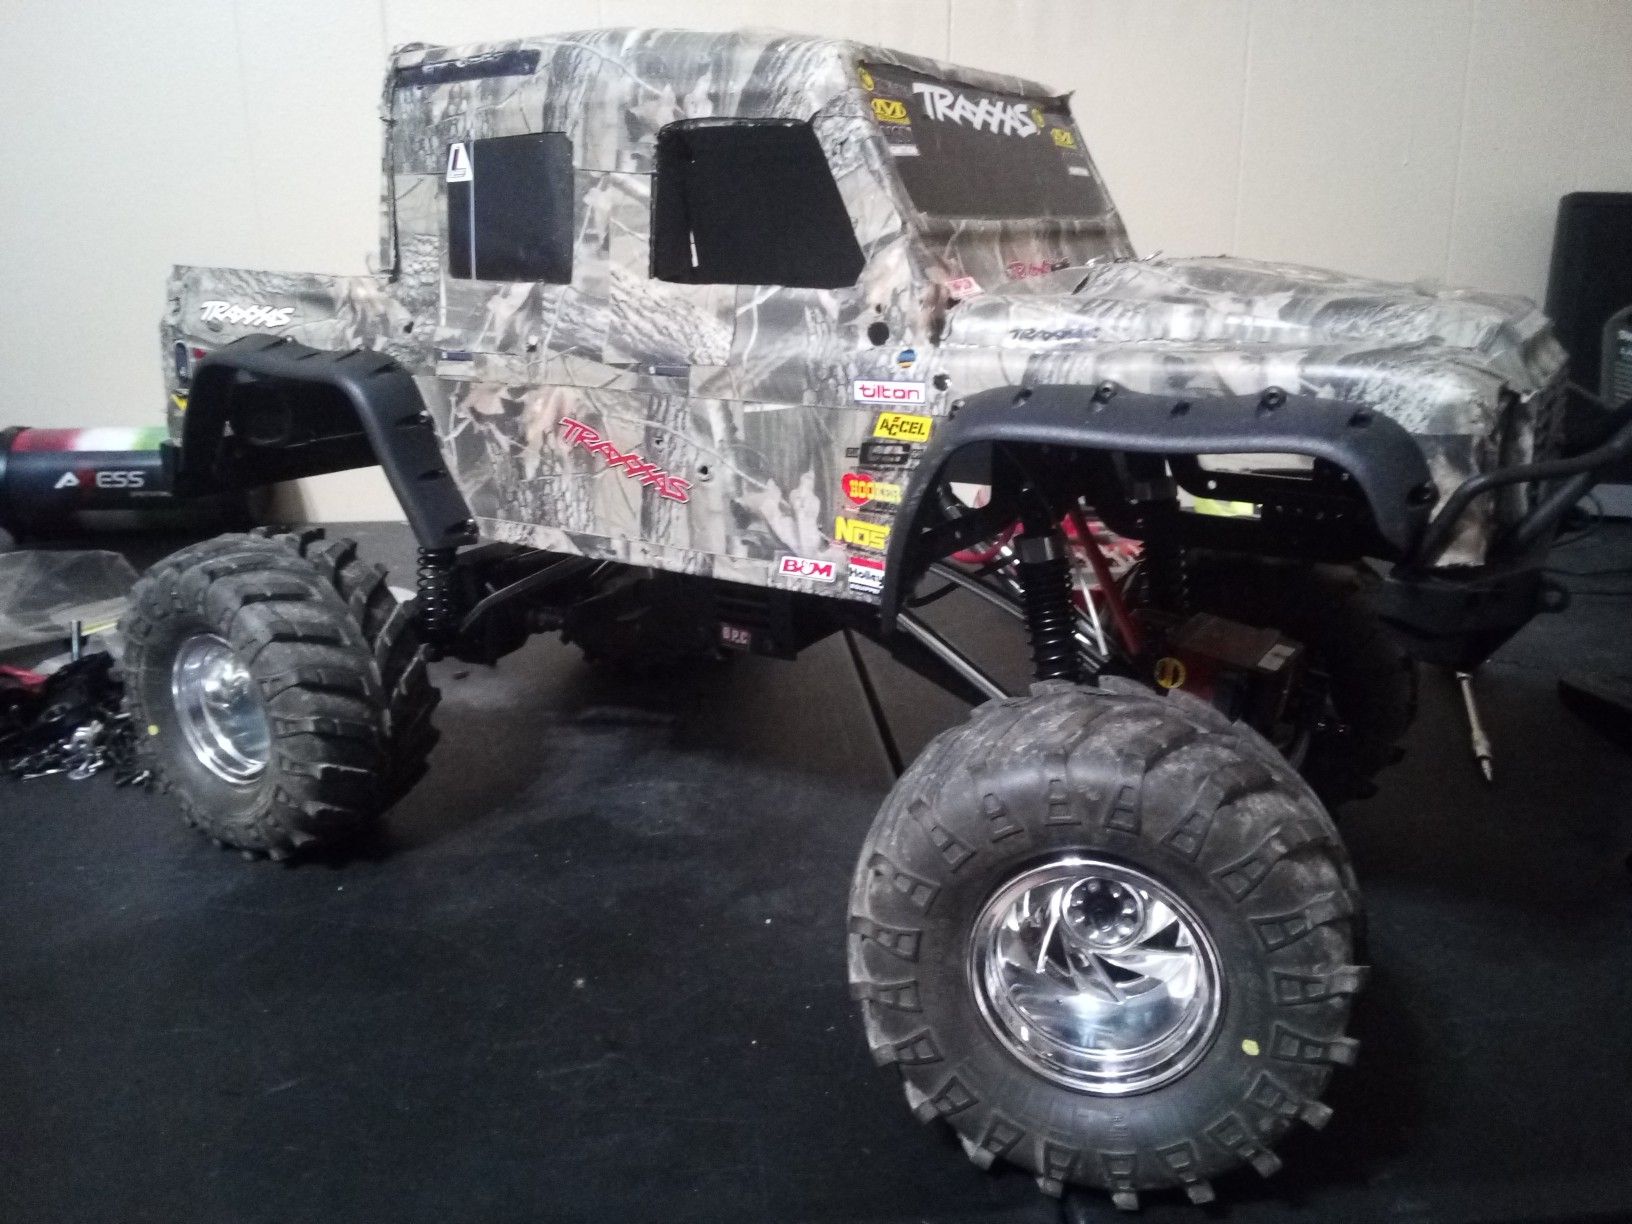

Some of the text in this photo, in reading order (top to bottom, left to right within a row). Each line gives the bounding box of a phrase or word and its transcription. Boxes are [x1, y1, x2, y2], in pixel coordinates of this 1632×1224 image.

[912, 82, 1038, 137] TRAXXAS
[200, 300, 295, 328] TRAXXAS
[859, 384, 920, 400] tilton
[880, 416, 925, 436] ACCEL
[559, 417, 693, 503] TRAXXAS
[835, 516, 891, 550] NOS
[782, 559, 832, 578] B&M
